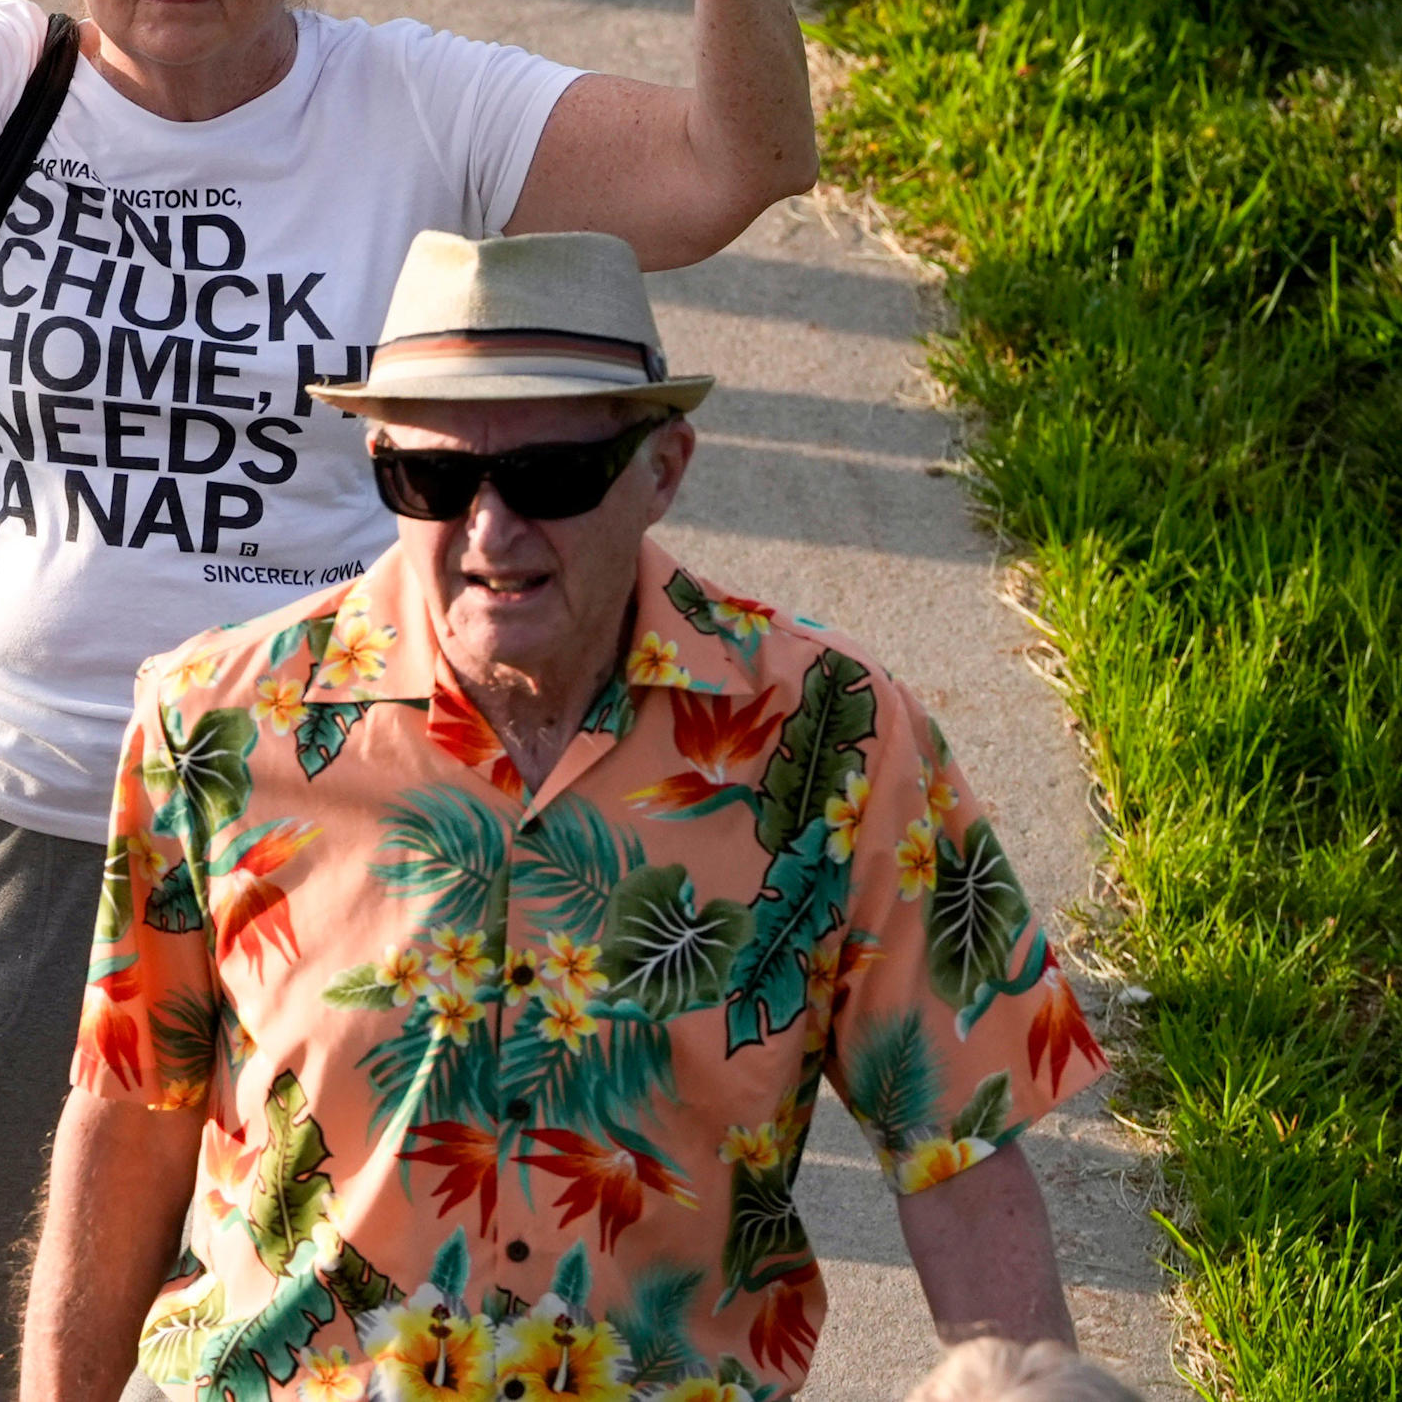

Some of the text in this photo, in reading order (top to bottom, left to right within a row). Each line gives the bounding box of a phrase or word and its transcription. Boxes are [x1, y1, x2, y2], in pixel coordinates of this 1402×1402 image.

[5, 165, 246, 271] SEND
[205, 187, 243, 209] DC,
[294, 344, 375, 419] H
[203, 559, 365, 587] SINCERELY, IOWA
